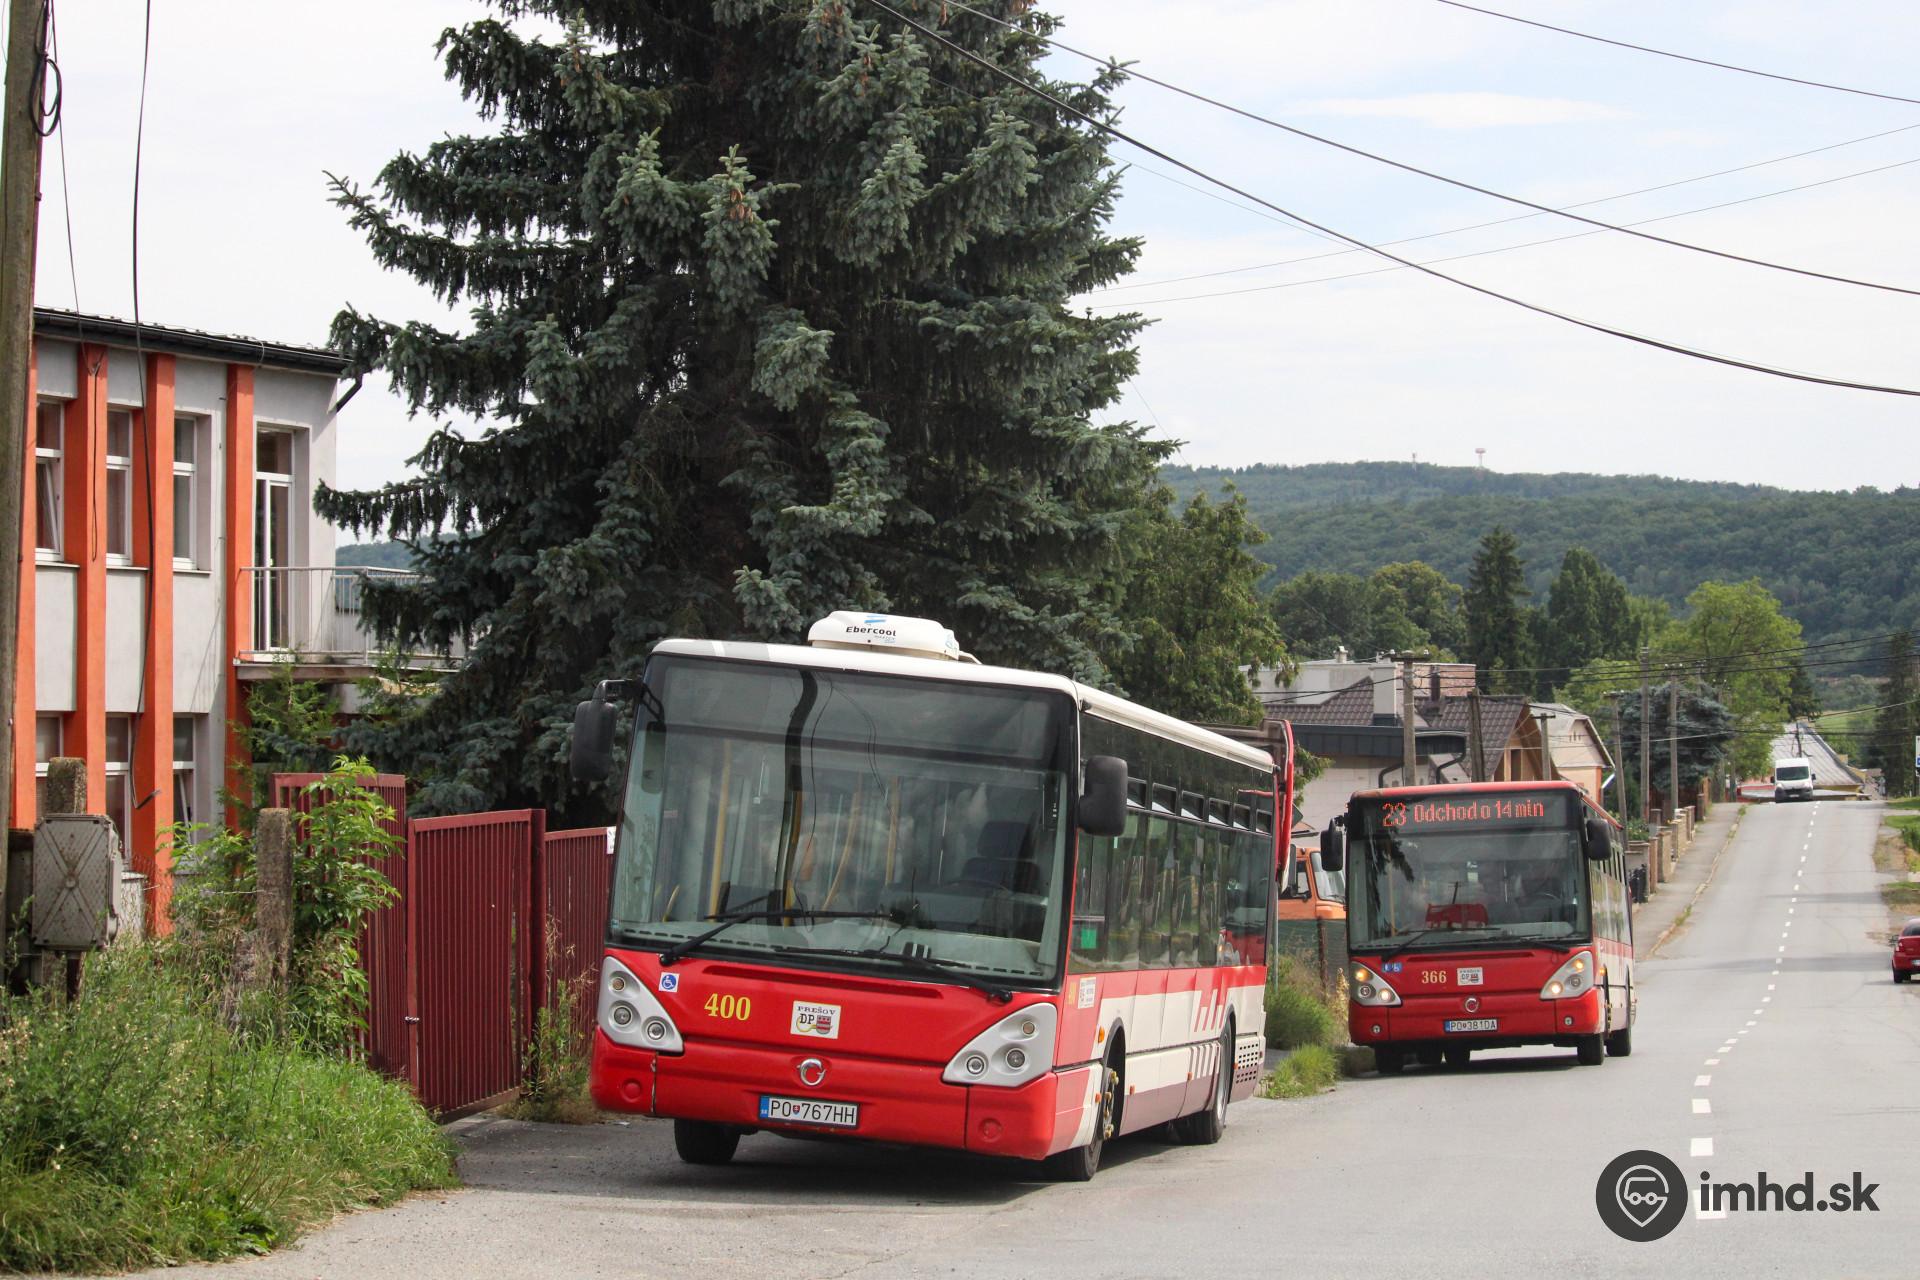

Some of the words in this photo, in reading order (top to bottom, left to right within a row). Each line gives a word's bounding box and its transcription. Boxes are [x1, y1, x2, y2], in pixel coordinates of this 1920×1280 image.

[846, 626, 896, 636] Ebercool
[1382, 802, 1407, 827] 23
[1413, 800, 1478, 823] Odchod
[1480, 804, 1491, 819] o
[1495, 799, 1512, 819] 14
[1515, 799, 1545, 818] min
[1421, 970, 1447, 984] 366
[704, 993, 750, 1021] 400
[800, 1013, 815, 1025] DP
